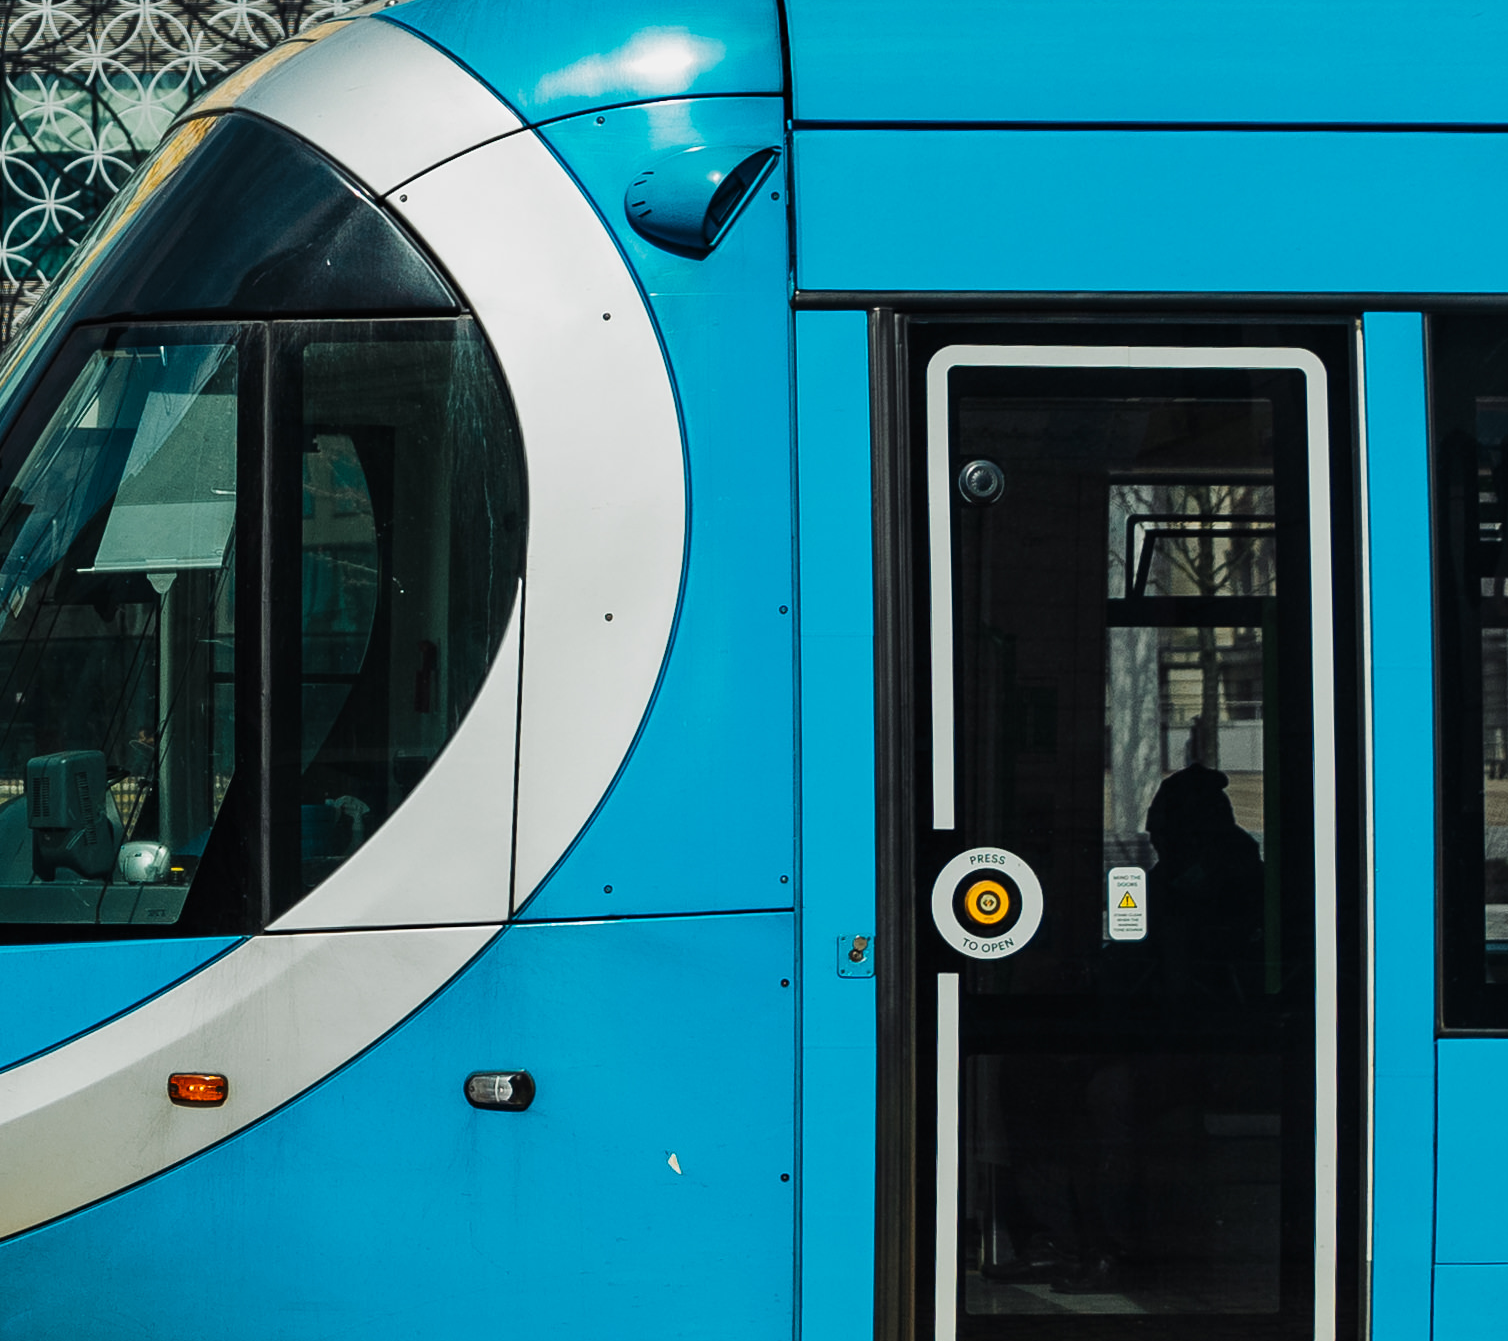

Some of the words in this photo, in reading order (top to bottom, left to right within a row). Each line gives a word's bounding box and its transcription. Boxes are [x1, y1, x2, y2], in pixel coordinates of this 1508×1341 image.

[969, 854, 1006, 865] PRESS
[963, 938, 978, 950] TO
[981, 938, 1015, 953] OPEN
